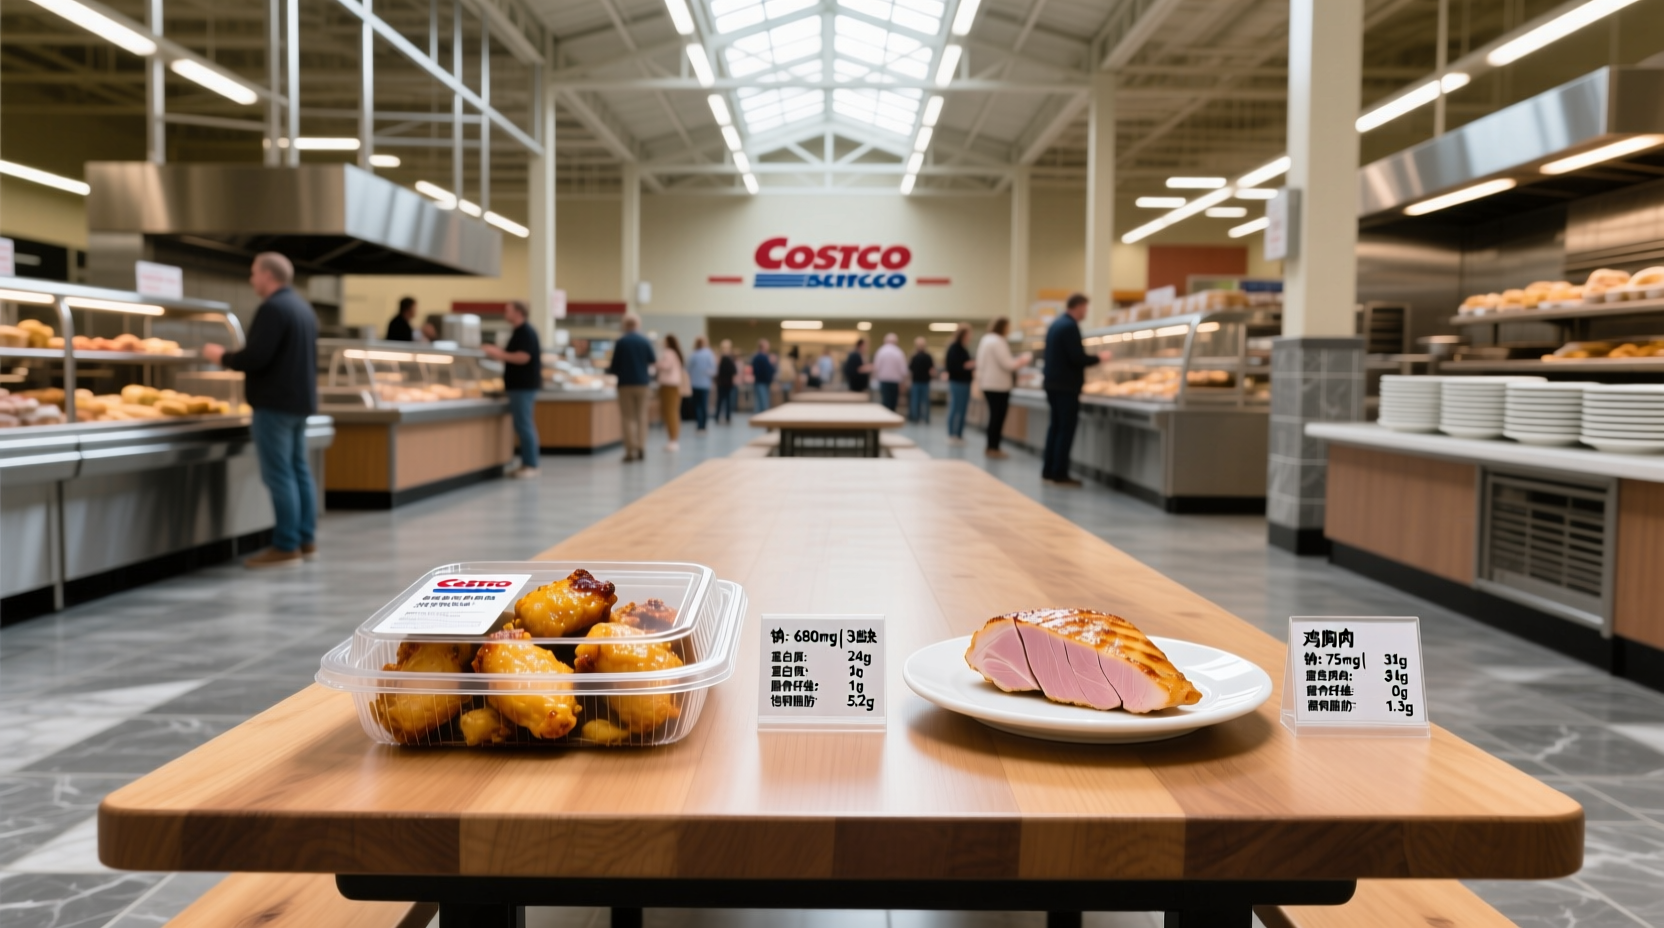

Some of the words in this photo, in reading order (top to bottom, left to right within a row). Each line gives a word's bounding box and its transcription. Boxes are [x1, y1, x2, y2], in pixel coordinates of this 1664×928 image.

[847, 650, 871, 666] 24g
[1383, 653, 1407, 669] 31g
[1391, 685, 1408, 700] 0g
[1386, 700, 1413, 717] 1.3g
